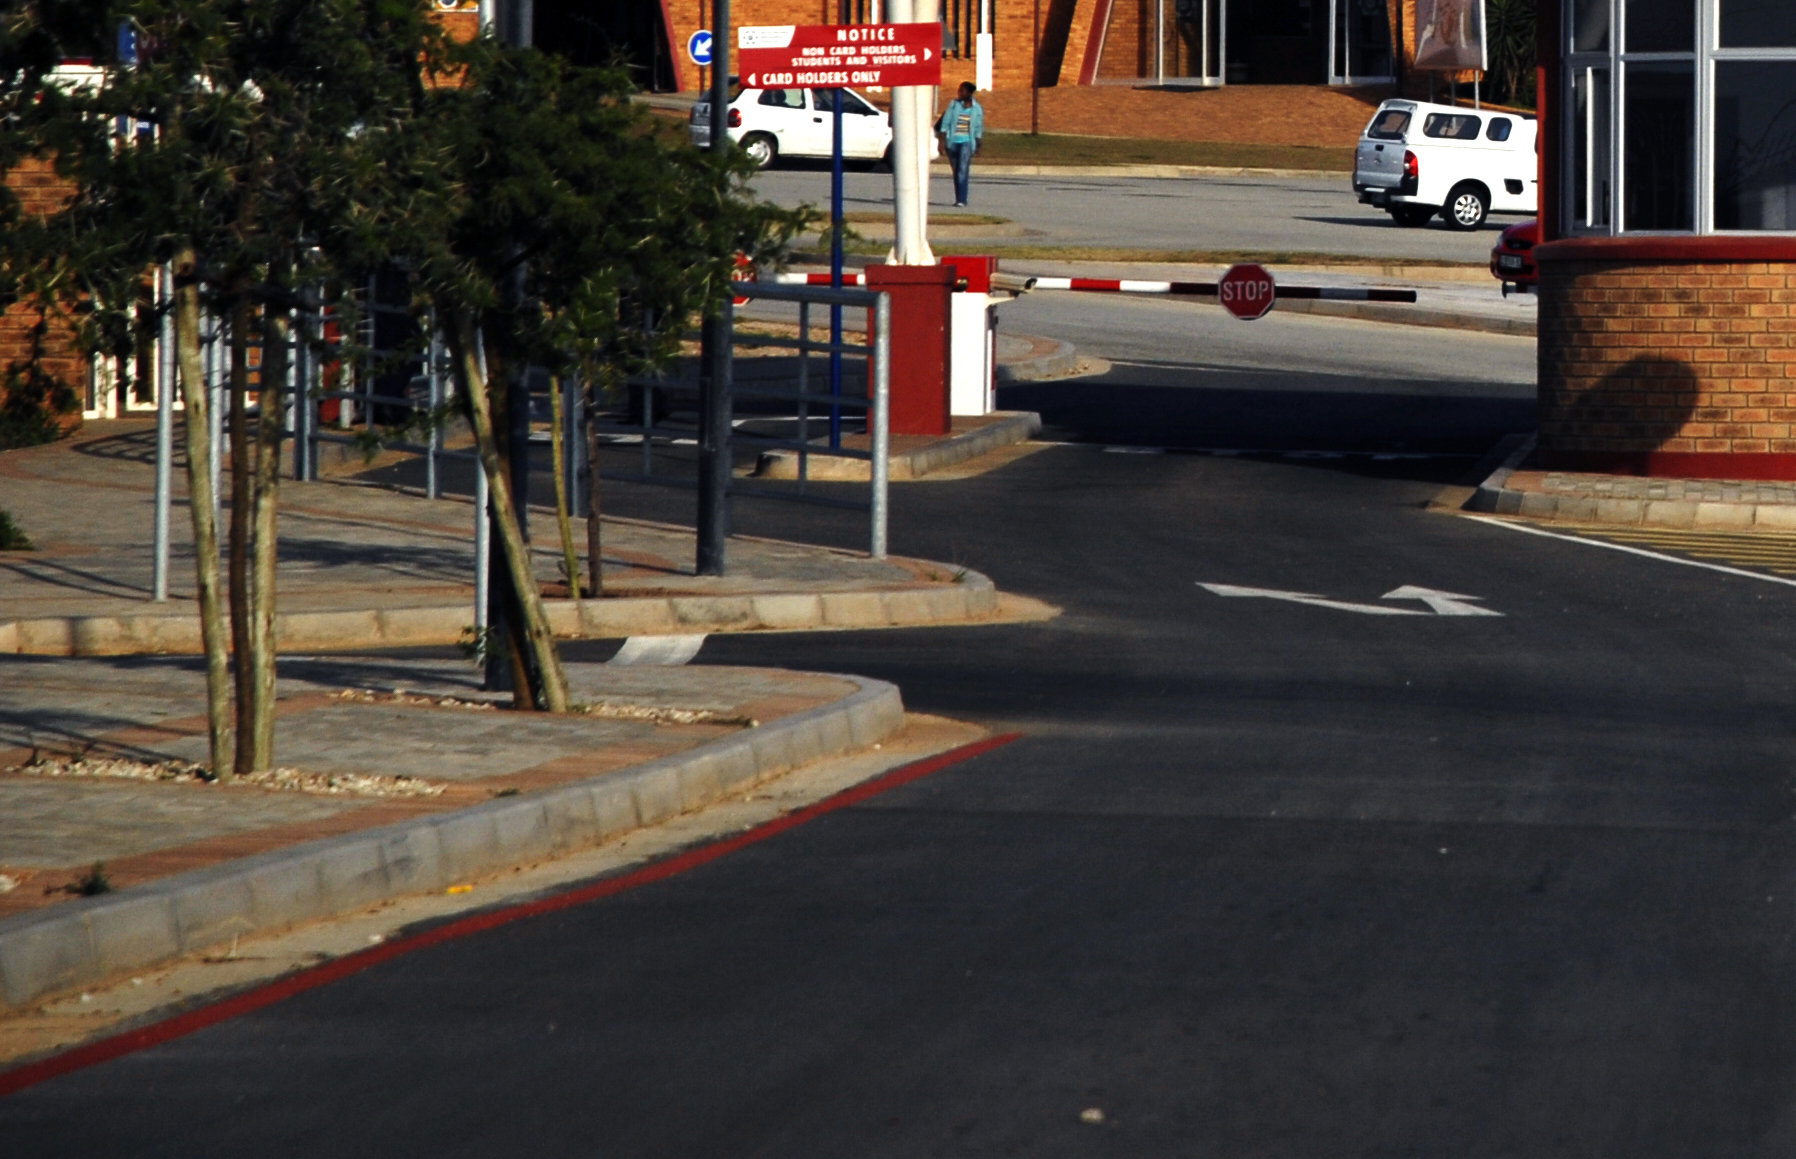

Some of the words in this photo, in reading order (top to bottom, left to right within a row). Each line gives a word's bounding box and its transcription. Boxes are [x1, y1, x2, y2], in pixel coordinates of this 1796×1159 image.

[837, 27, 895, 42] NOTICE
[802, 46, 825, 56] NON
[829, 46, 856, 56] CARD
[861, 44, 906, 55] HOLDERS
[791, 56, 841, 67] STUDENTS
[845, 55, 868, 65] AND
[872, 54, 917, 65] VISITORS
[762, 72, 793, 86] CARD
[796, 70, 849, 85] HOLDERS
[851, 70, 881, 83] ONLY
[1223, 280, 1269, 301] STOP
